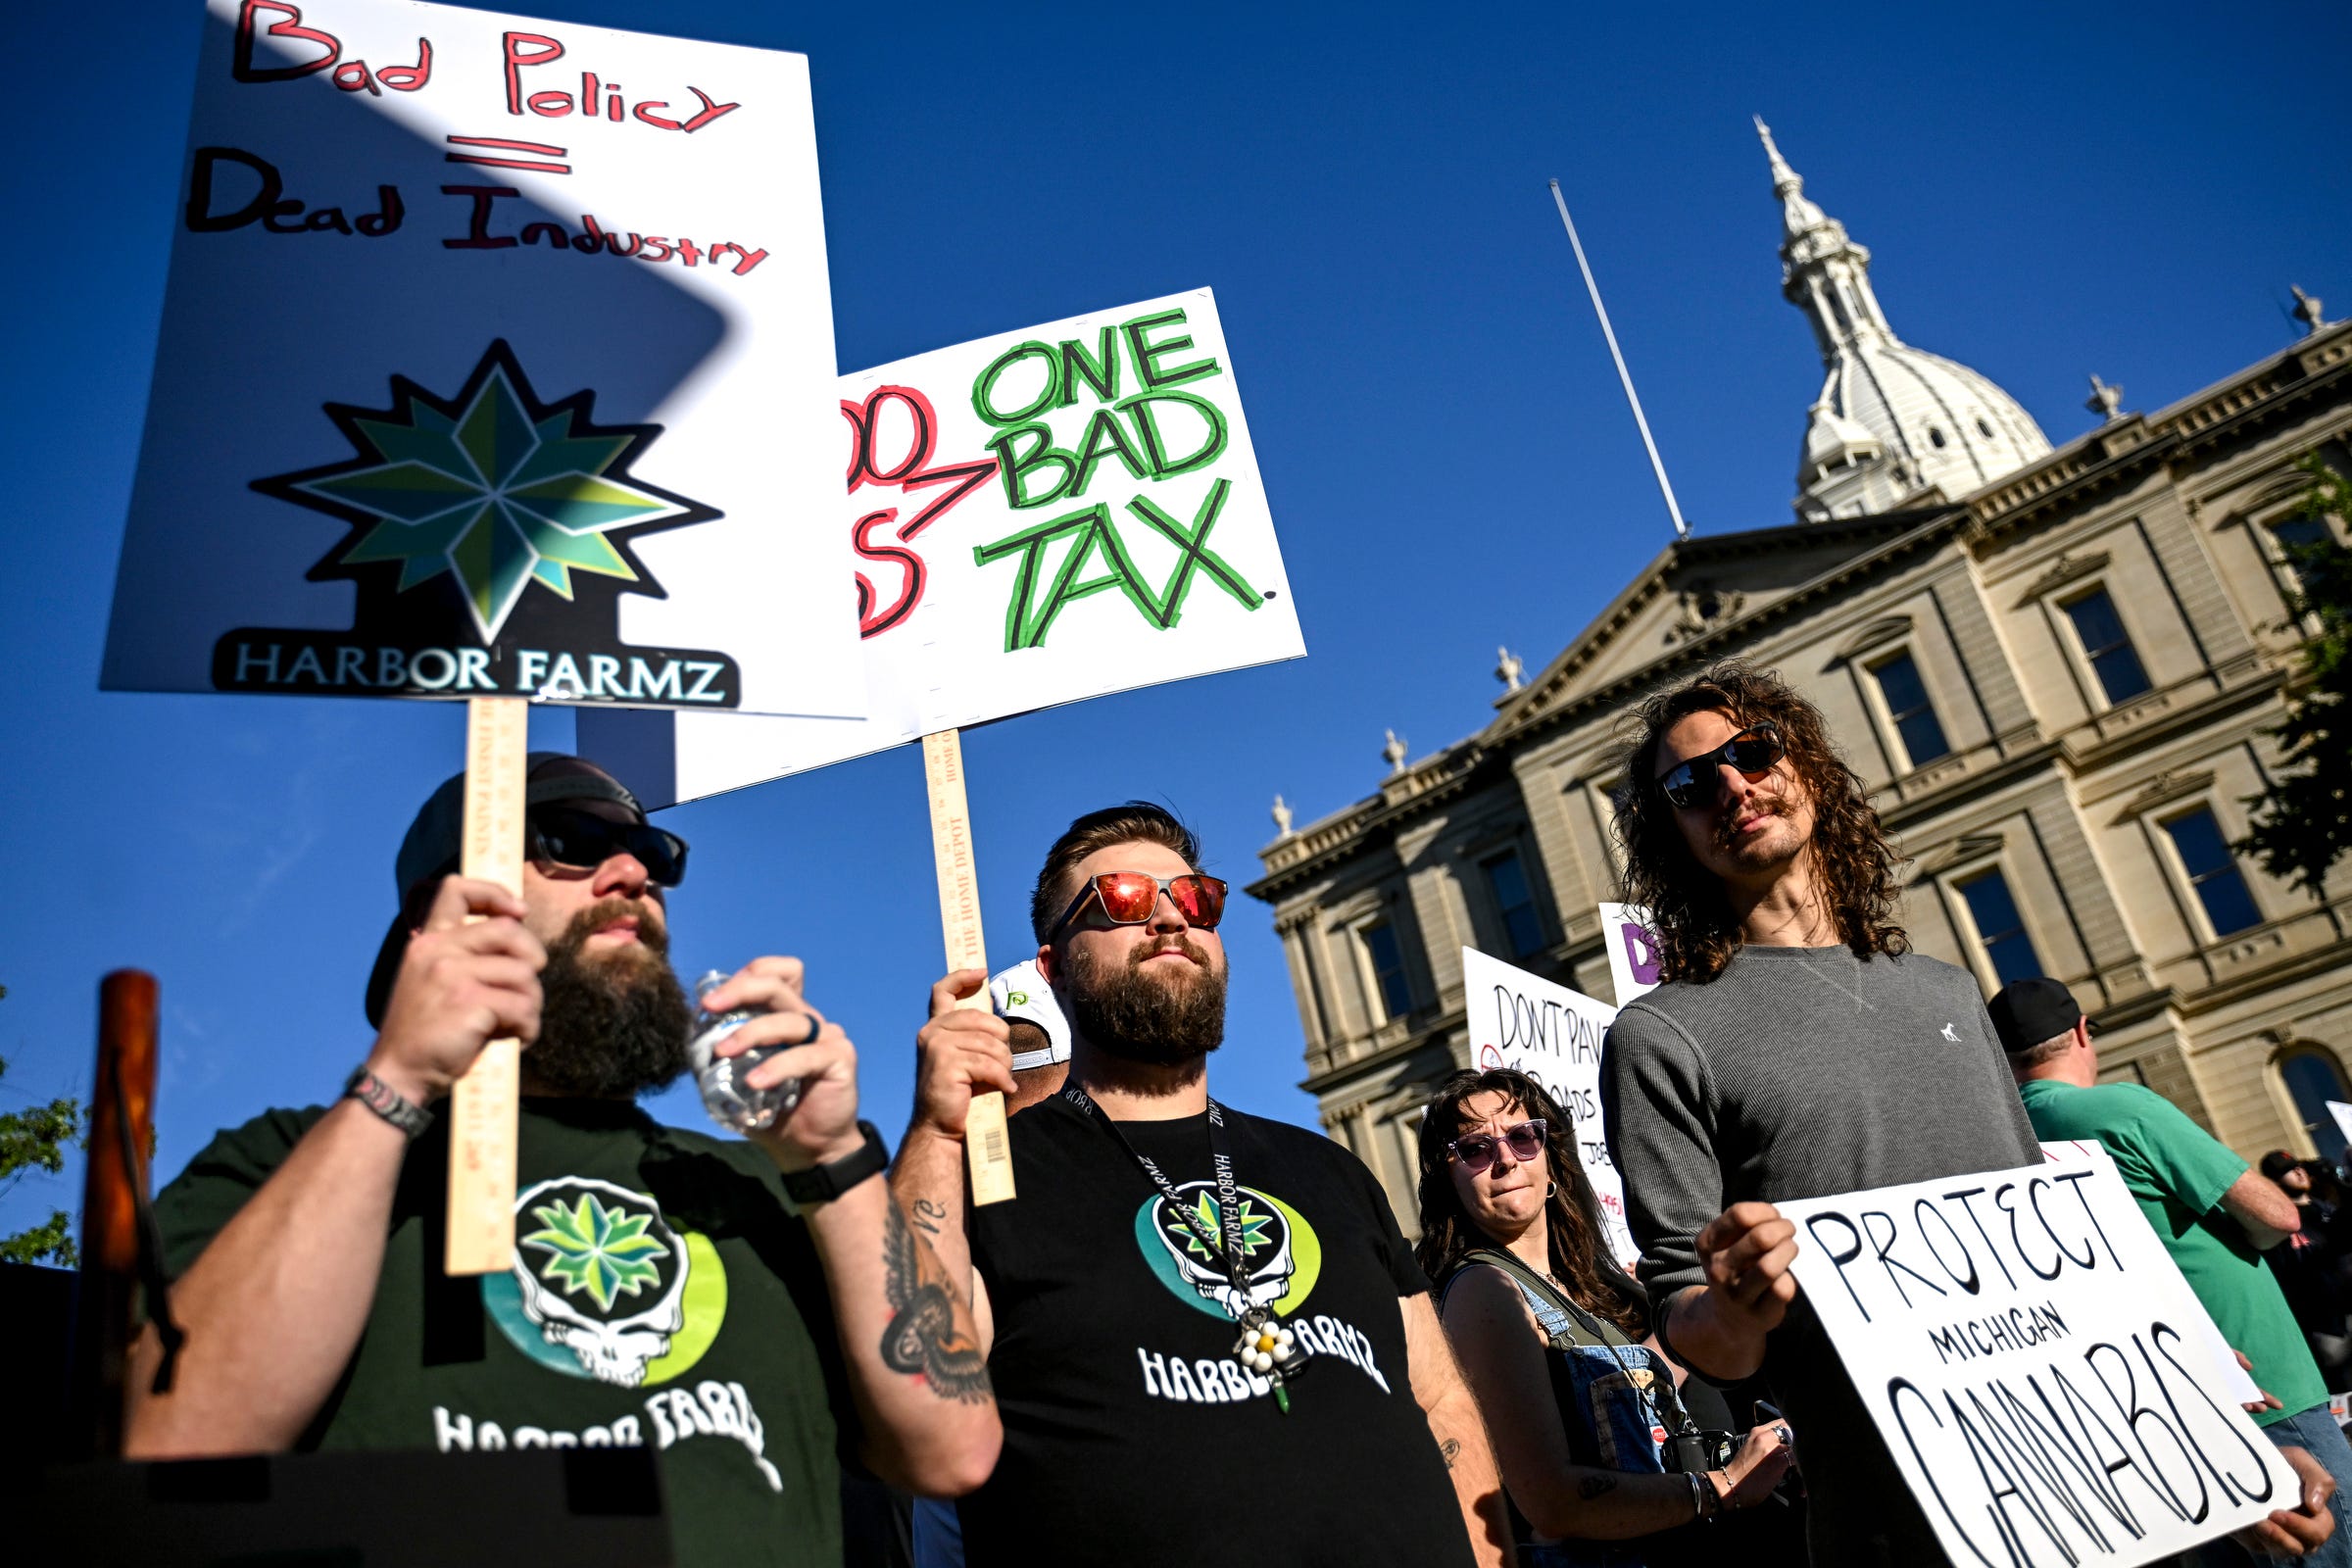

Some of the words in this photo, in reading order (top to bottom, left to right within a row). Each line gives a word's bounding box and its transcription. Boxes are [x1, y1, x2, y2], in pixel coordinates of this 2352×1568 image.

[232, 0, 432, 95] Bad
[502, 31, 740, 132] Policy
[185, 147, 404, 235] Dead
[441, 185, 769, 275] Industry
[971, 308, 1222, 427] ONE
[983, 389, 1228, 510] BAD
[236, 643, 498, 690] HARBOR
[518, 651, 727, 703] FARMZ
[942, 745, 957, 783] HOME
[950, 815, 967, 867] DEPOT
[956, 870, 973, 921] HOME
[963, 924, 978, 958] THE
[1564, 1007, 1610, 1067] PAV
[1214, 1153, 1238, 1204] HARBOR
[1222, 1205, 1245, 1255] FARMZ
[1805, 1170, 2125, 1323] PROTECT
[1293, 1315, 1392, 1395] ARMZ
[1927, 1300, 2072, 1365] MICHIGAN
[1887, 1321, 2274, 1568] CANNABIS
